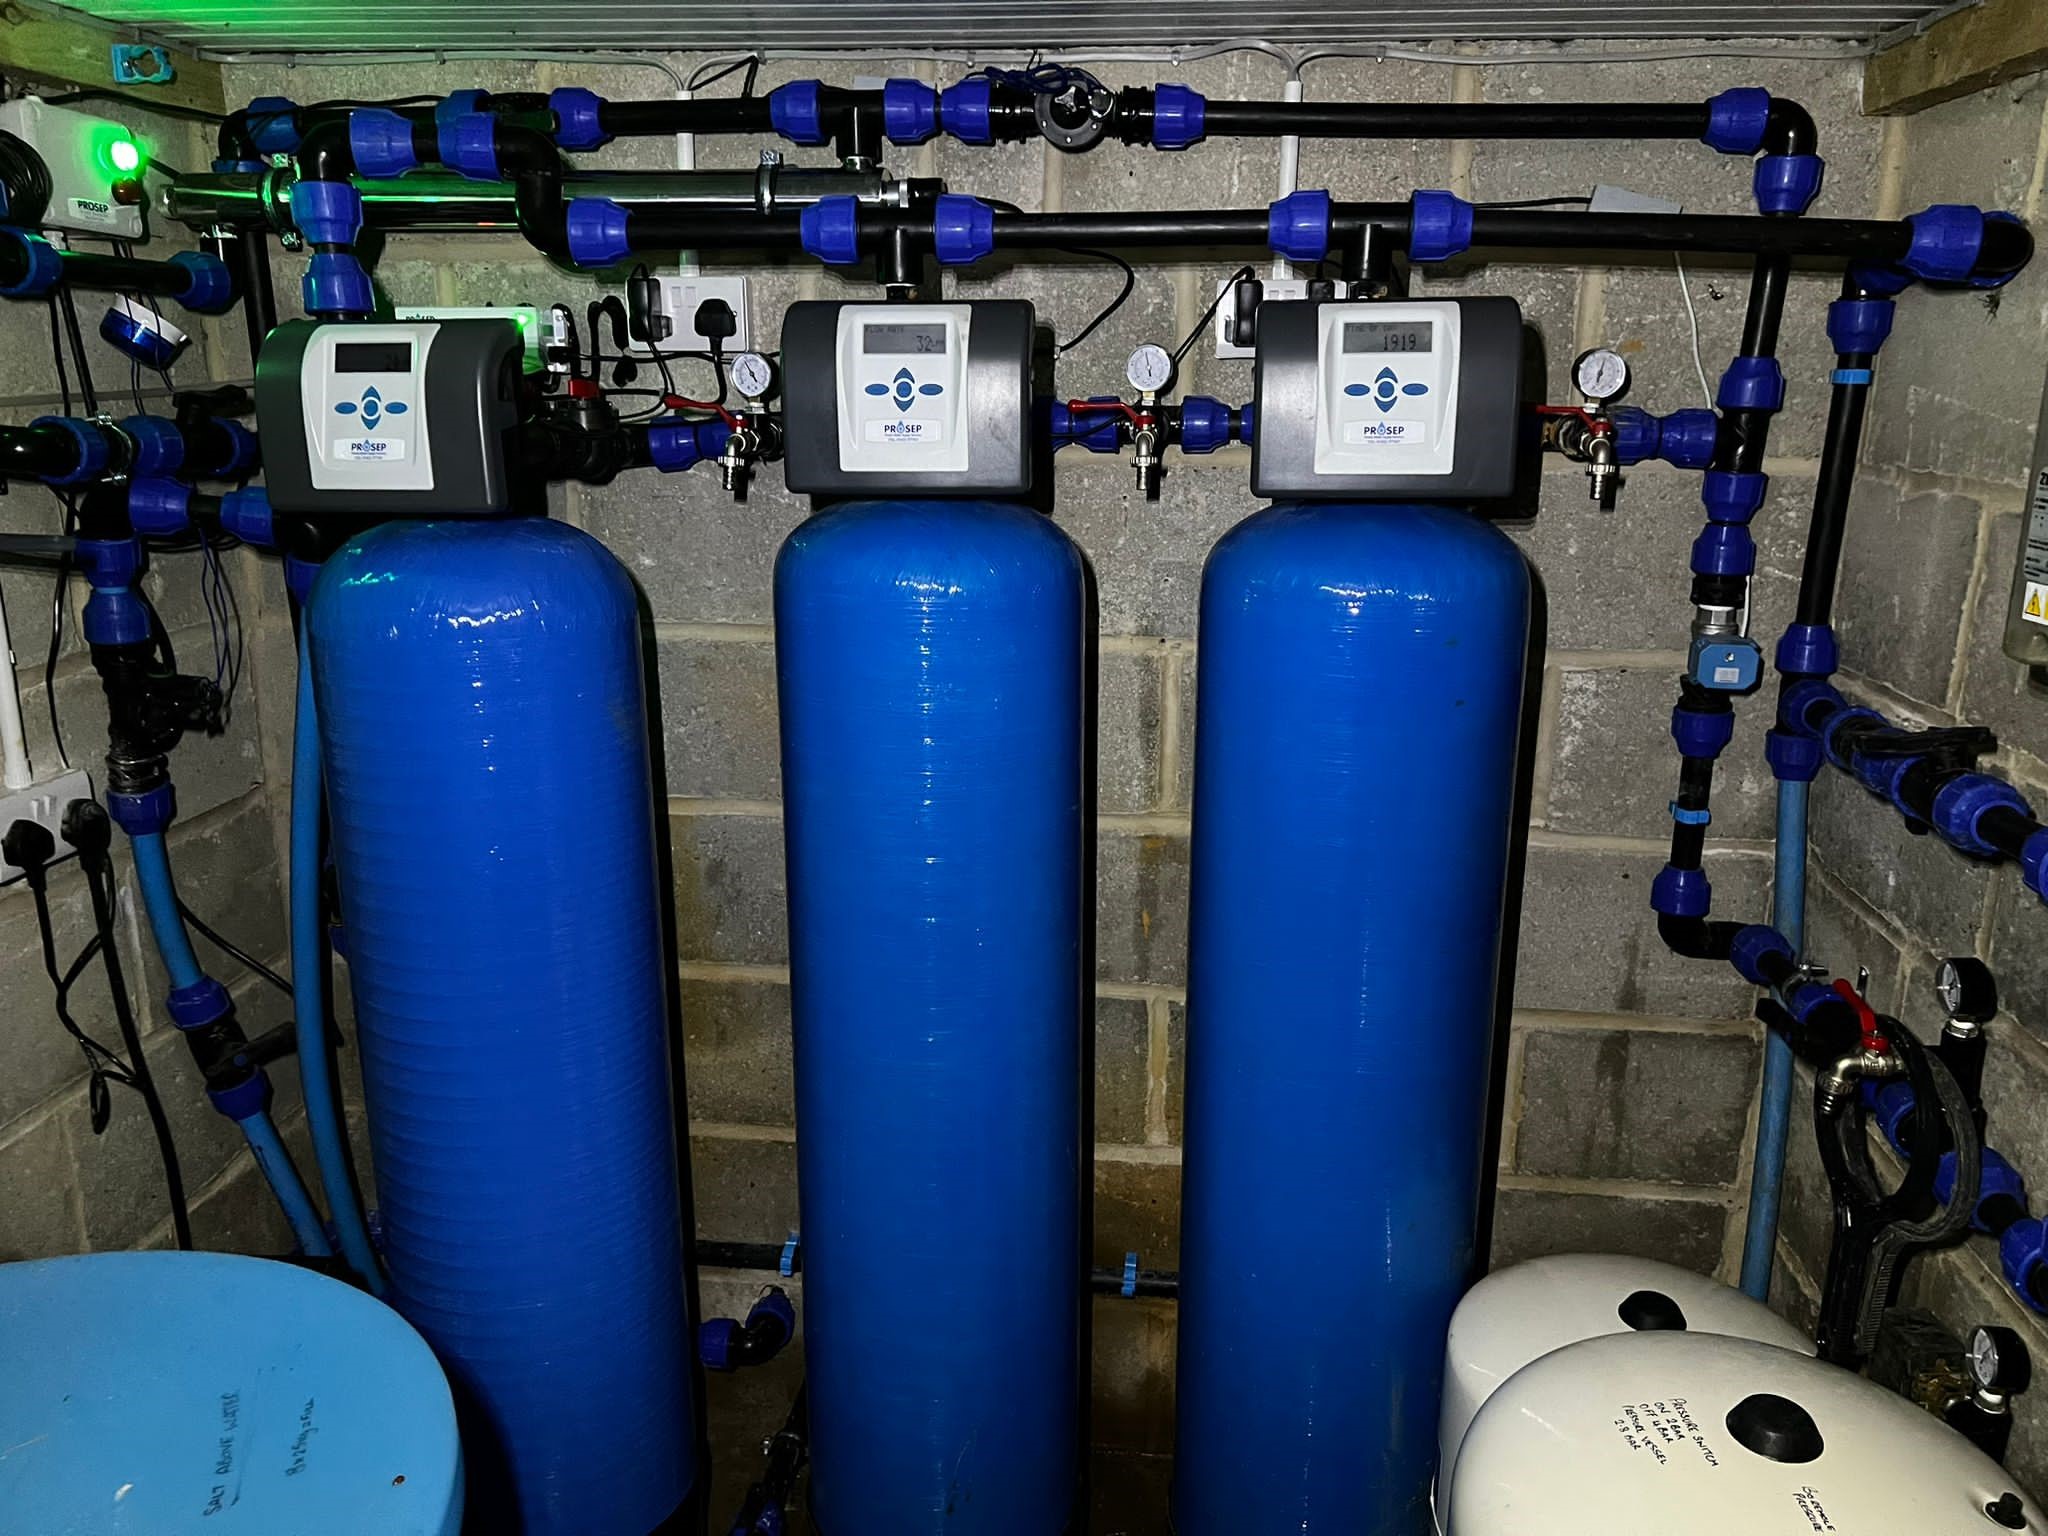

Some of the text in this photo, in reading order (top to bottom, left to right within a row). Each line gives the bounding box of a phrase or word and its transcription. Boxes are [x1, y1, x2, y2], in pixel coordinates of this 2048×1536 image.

[77, 200, 109, 212] PROSEP
[883, 420, 922, 433] PROSEP
[1363, 421, 1405, 435] PROSEP
[351, 439, 387, 452] PROSEP
[1639, 1403, 1658, 1417] OFF
[1654, 1401, 1671, 1414] ON
[203, 1485, 225, 1516] SALT
